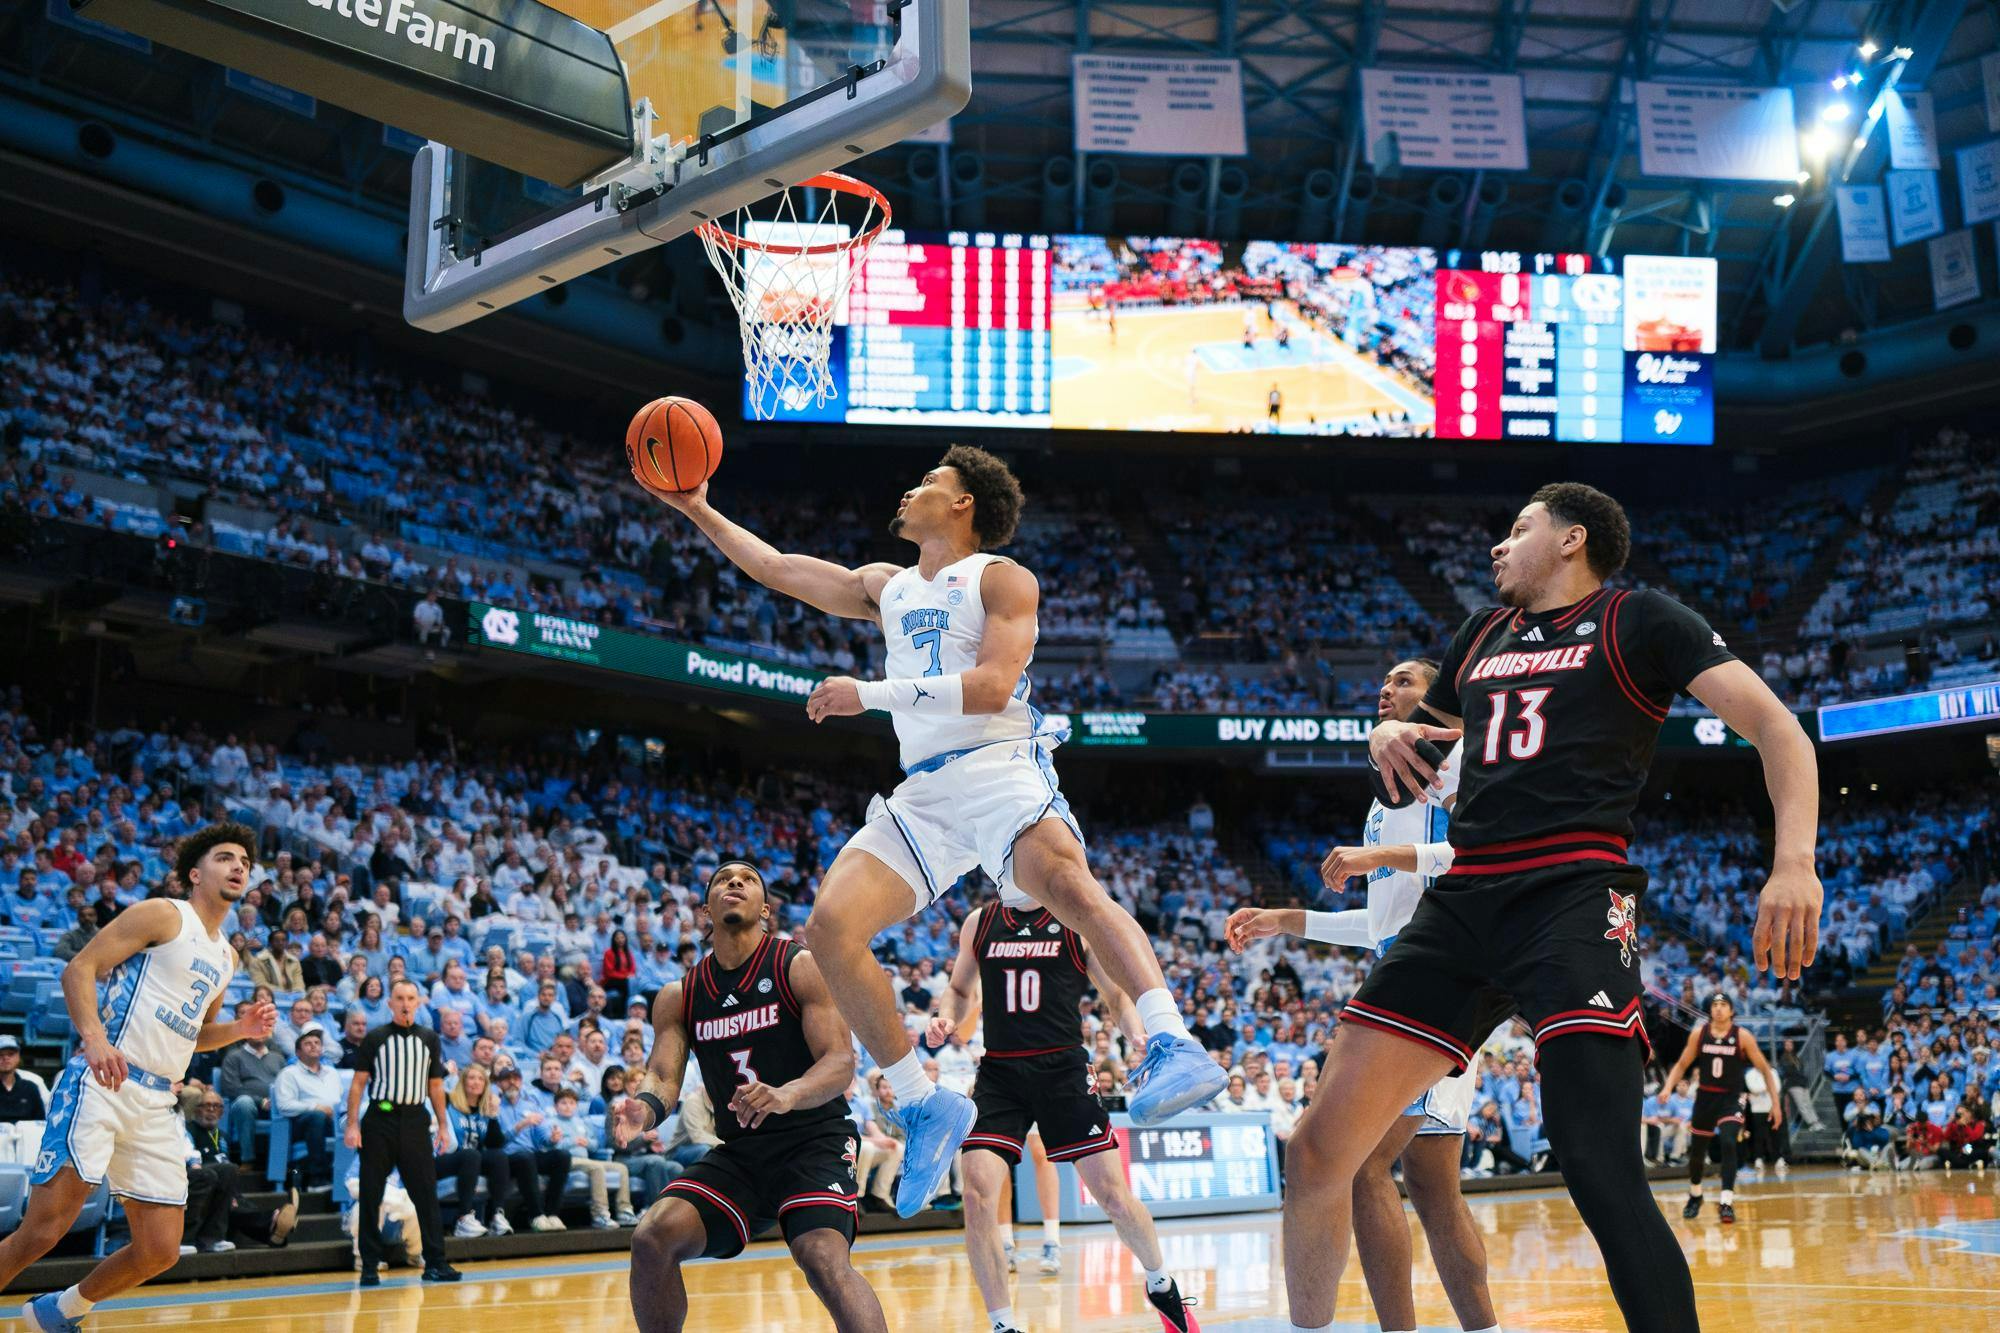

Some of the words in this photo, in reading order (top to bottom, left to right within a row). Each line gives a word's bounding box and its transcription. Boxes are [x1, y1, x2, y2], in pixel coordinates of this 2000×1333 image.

[901, 608, 950, 637] NORTH
[687, 651, 744, 684] Proud
[746, 663, 814, 697] Partner
[912, 629, 943, 678] 7
[1467, 643, 1595, 684] LOUISVILLE
[1218, 718, 1266, 741] BUY
[1269, 718, 1320, 741] AND
[1482, 687, 1555, 766] 13
[986, 940, 1062, 961] LOUISVILLE
[189, 957, 221, 988] NORTH
[1003, 967, 1041, 1014] 10
[181, 979, 210, 1020] 3
[695, 1002, 780, 1043] LOUISVILLE
[727, 1047, 758, 1087] 3
[1712, 1056, 1724, 1079] 0
